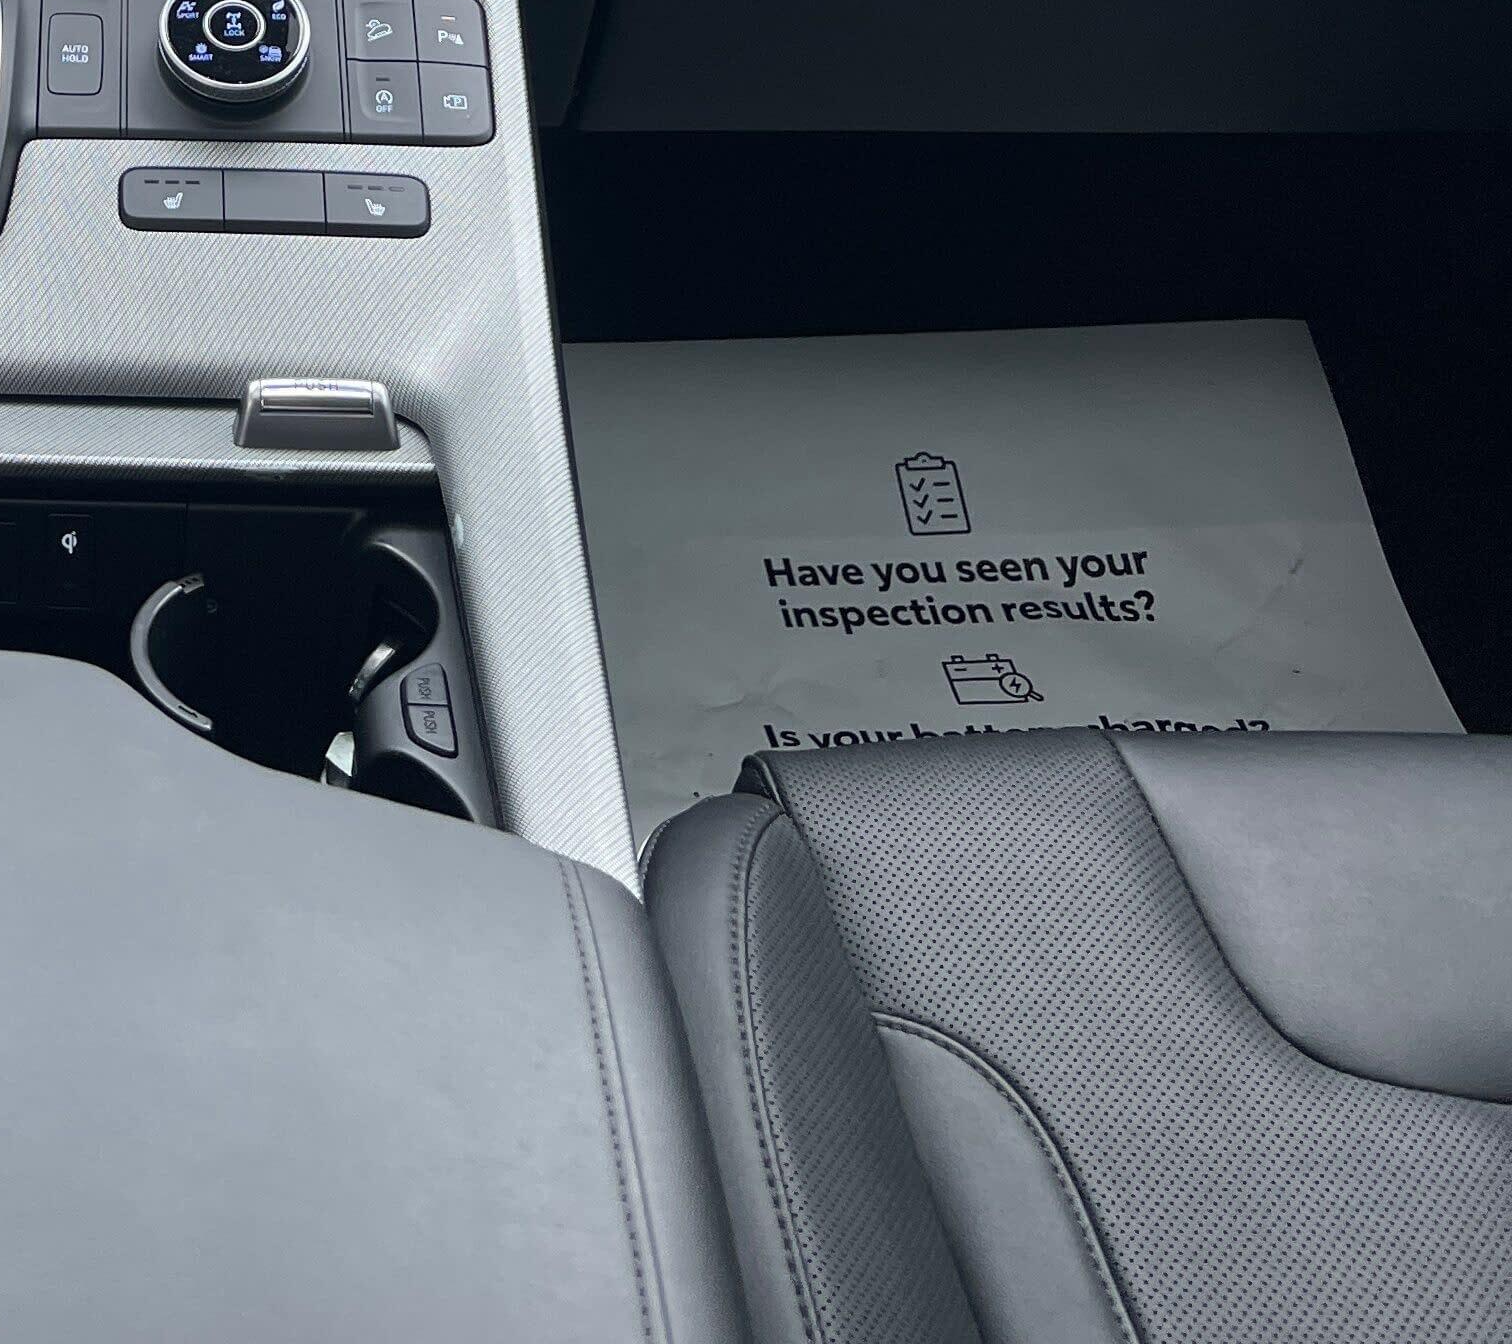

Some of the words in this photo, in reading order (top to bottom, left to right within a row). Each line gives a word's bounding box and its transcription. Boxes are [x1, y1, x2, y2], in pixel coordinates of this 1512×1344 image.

[177, 12, 199, 20] SPORT
[223, 29, 245, 37] LOCK
[62, 44, 89, 54] AUTO
[61, 53, 89, 64] HOLD
[188, 53, 214, 62] SMART
[375, 105, 393, 113] OFF
[763, 557, 865, 587] Have
[870, 560, 947, 592] you
[955, 556, 1049, 584] seen
[1056, 550, 1148, 588] your
[777, 595, 994, 635] inspection
[1001, 589, 1156, 622] results?
[763, 724, 801, 748] Is
